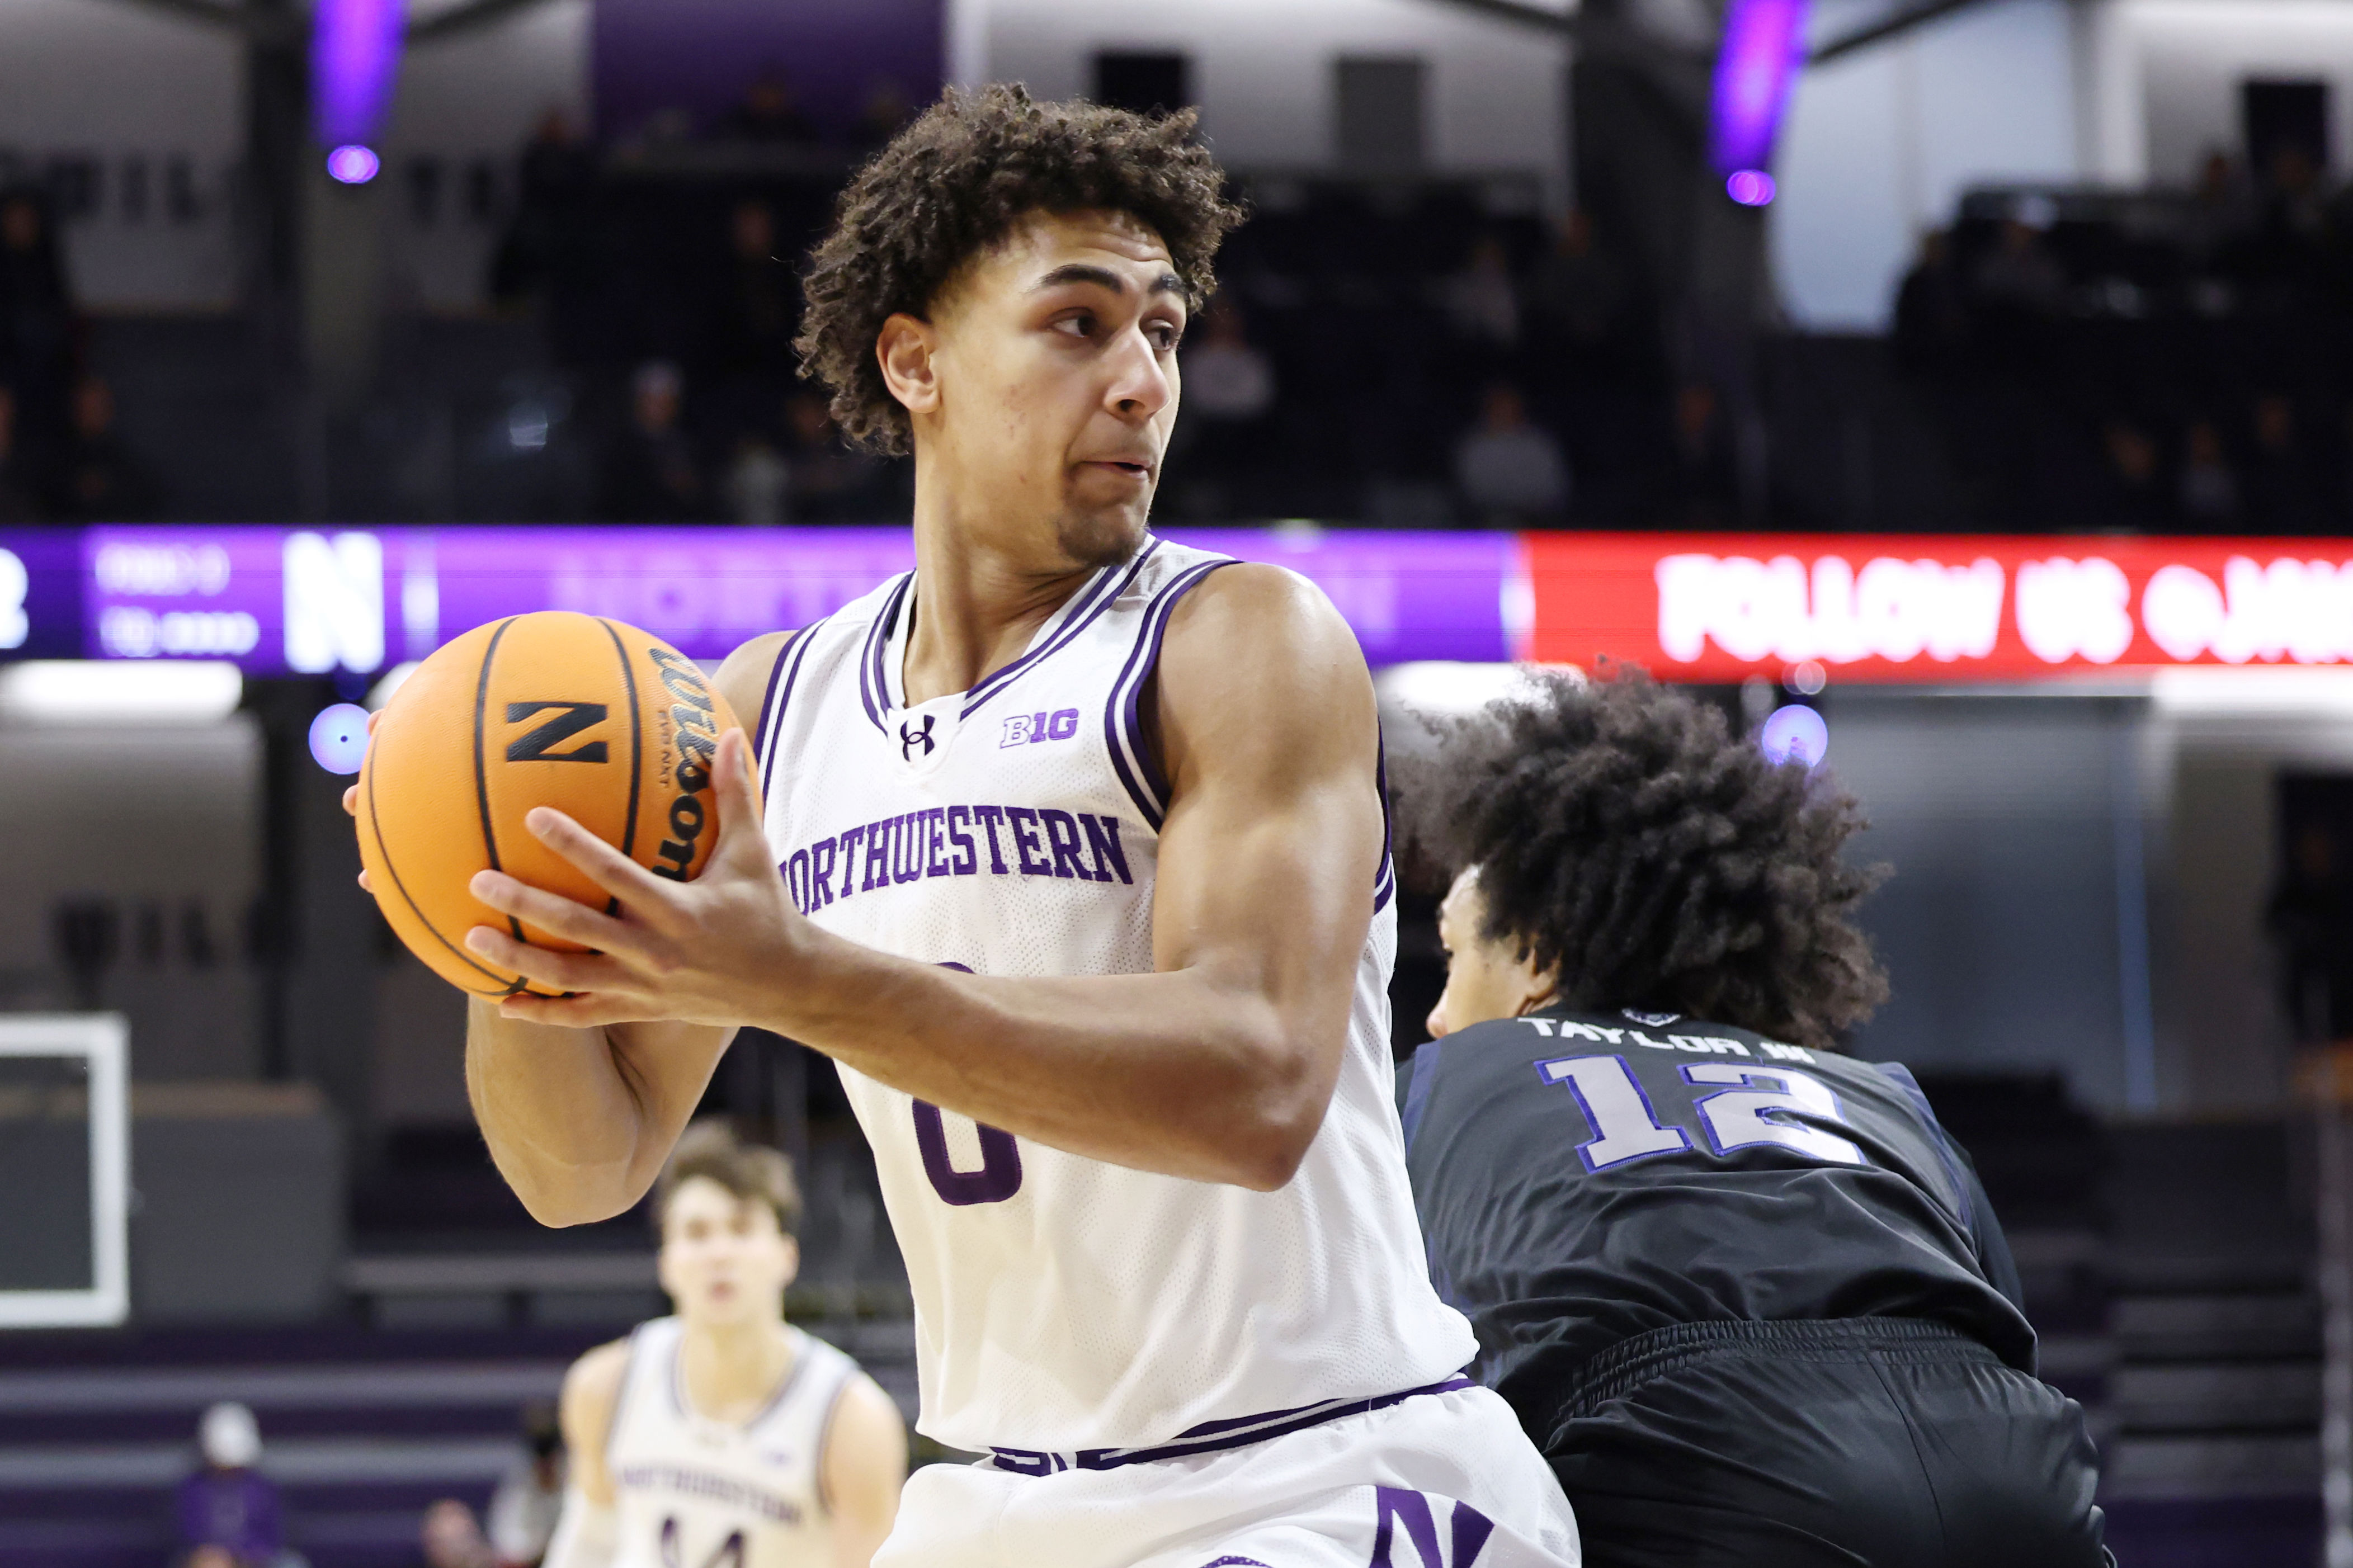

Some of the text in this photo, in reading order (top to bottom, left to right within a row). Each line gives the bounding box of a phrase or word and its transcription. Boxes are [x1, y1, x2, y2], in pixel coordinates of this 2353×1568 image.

[1654, 554, 2006, 664] FOLLOW
[2015, 555, 2134, 664] US
[506, 701, 609, 763] N
[778, 805, 1134, 917] ORTHWESTERN
[1517, 1017, 1817, 1064] TAYLOR III
[1534, 1054, 1867, 1174] 12
